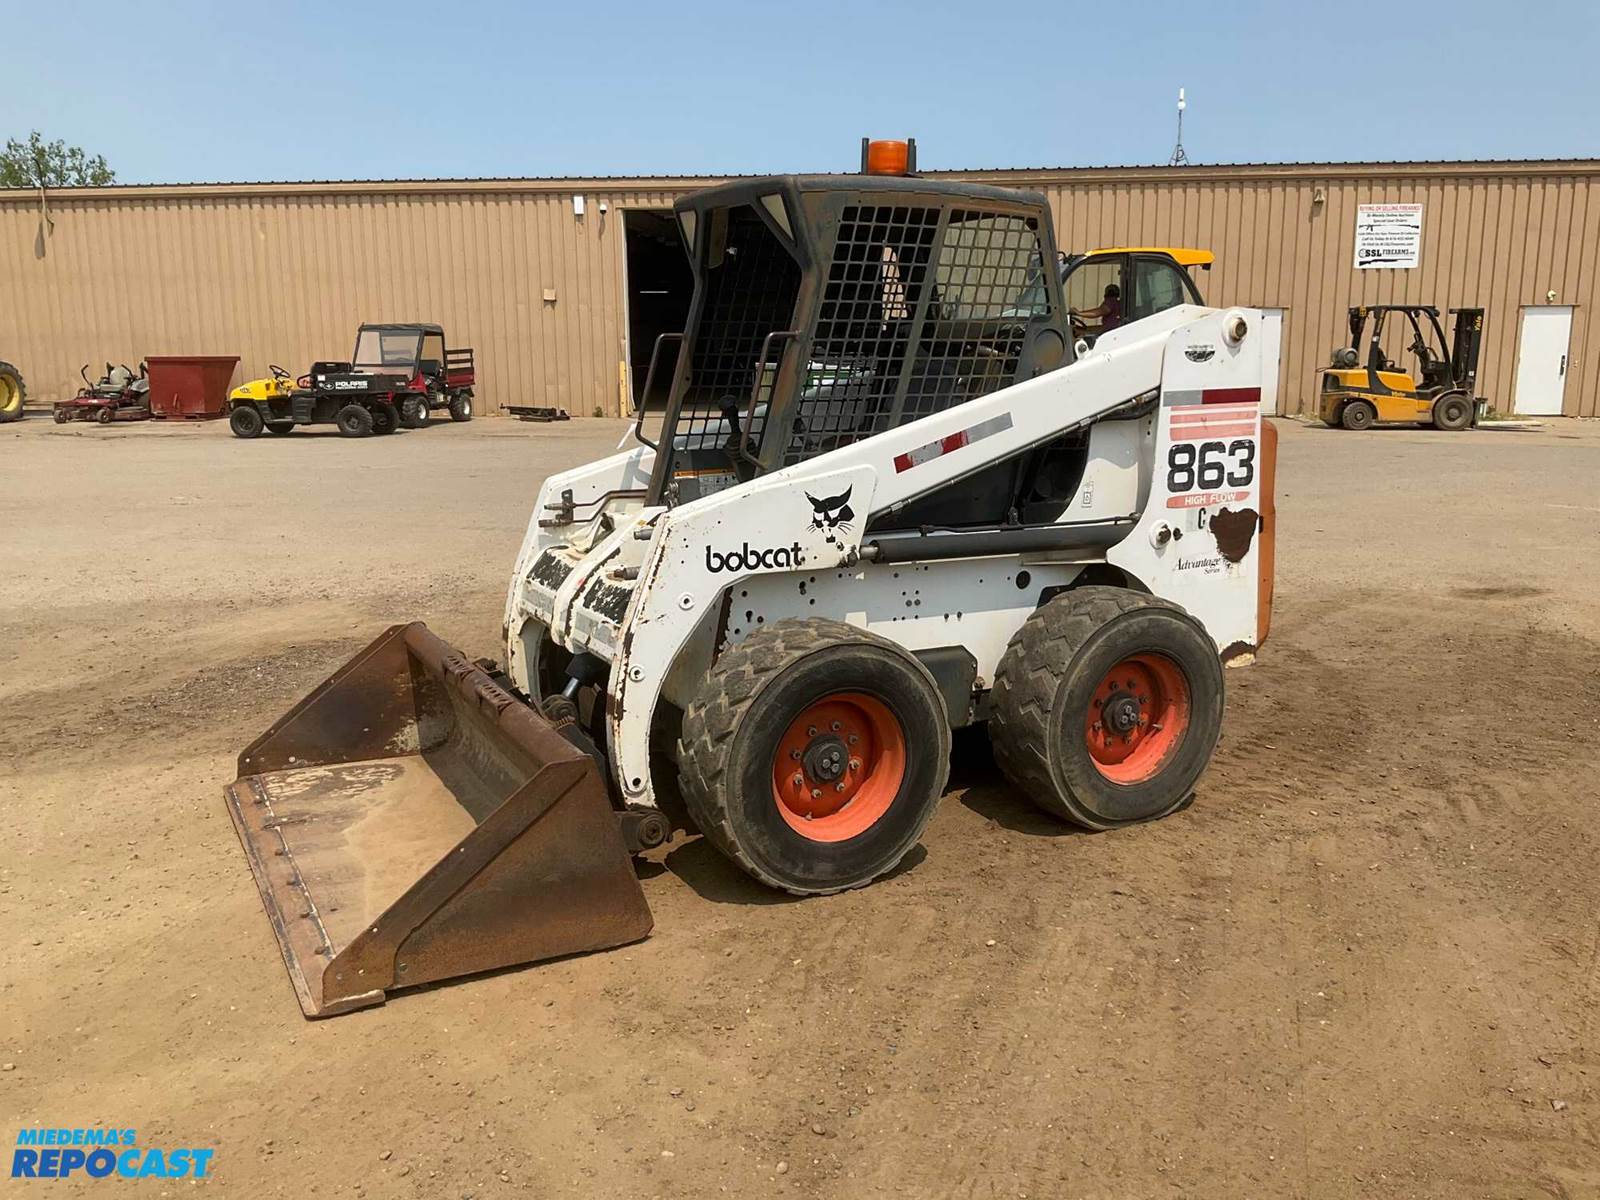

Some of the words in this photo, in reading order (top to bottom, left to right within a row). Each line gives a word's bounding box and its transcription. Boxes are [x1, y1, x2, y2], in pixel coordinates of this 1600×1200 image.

[1365, 249, 1382, 257] SSL
[1167, 439, 1255, 493] 863
[1184, 495, 1206, 506] HIGH
[1210, 492, 1236, 502] FLOW
[705, 542, 802, 573] bobcat
[1173, 557, 1220, 571] Advantage
